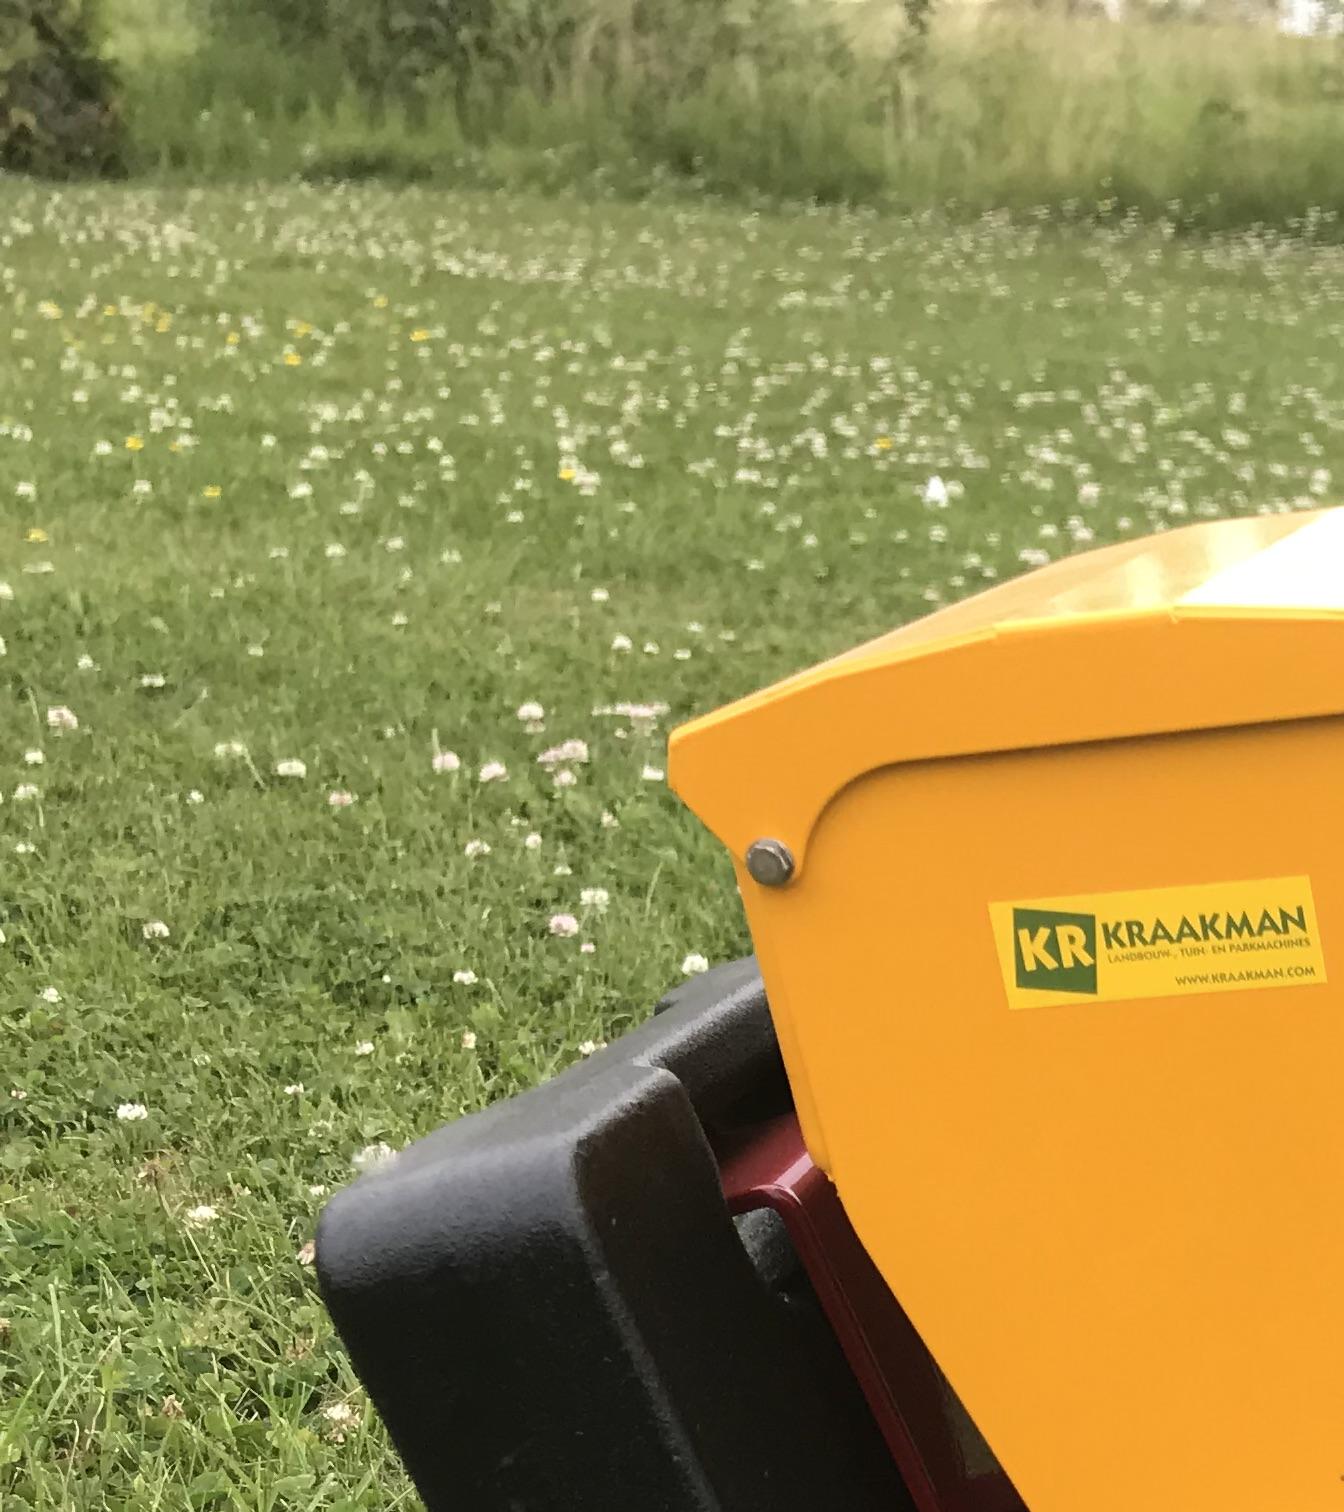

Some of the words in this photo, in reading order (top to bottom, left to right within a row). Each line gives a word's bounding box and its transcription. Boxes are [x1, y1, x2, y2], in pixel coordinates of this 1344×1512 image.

[1018, 925, 1095, 972] KR
[1101, 905, 1307, 950] KRAAKMAN
[1211, 944, 1226, 954] EN
[1229, 937, 1311, 952] PARKMACHINES
[1175, 966, 1316, 985] WWW.KRAAKMAN.COM
